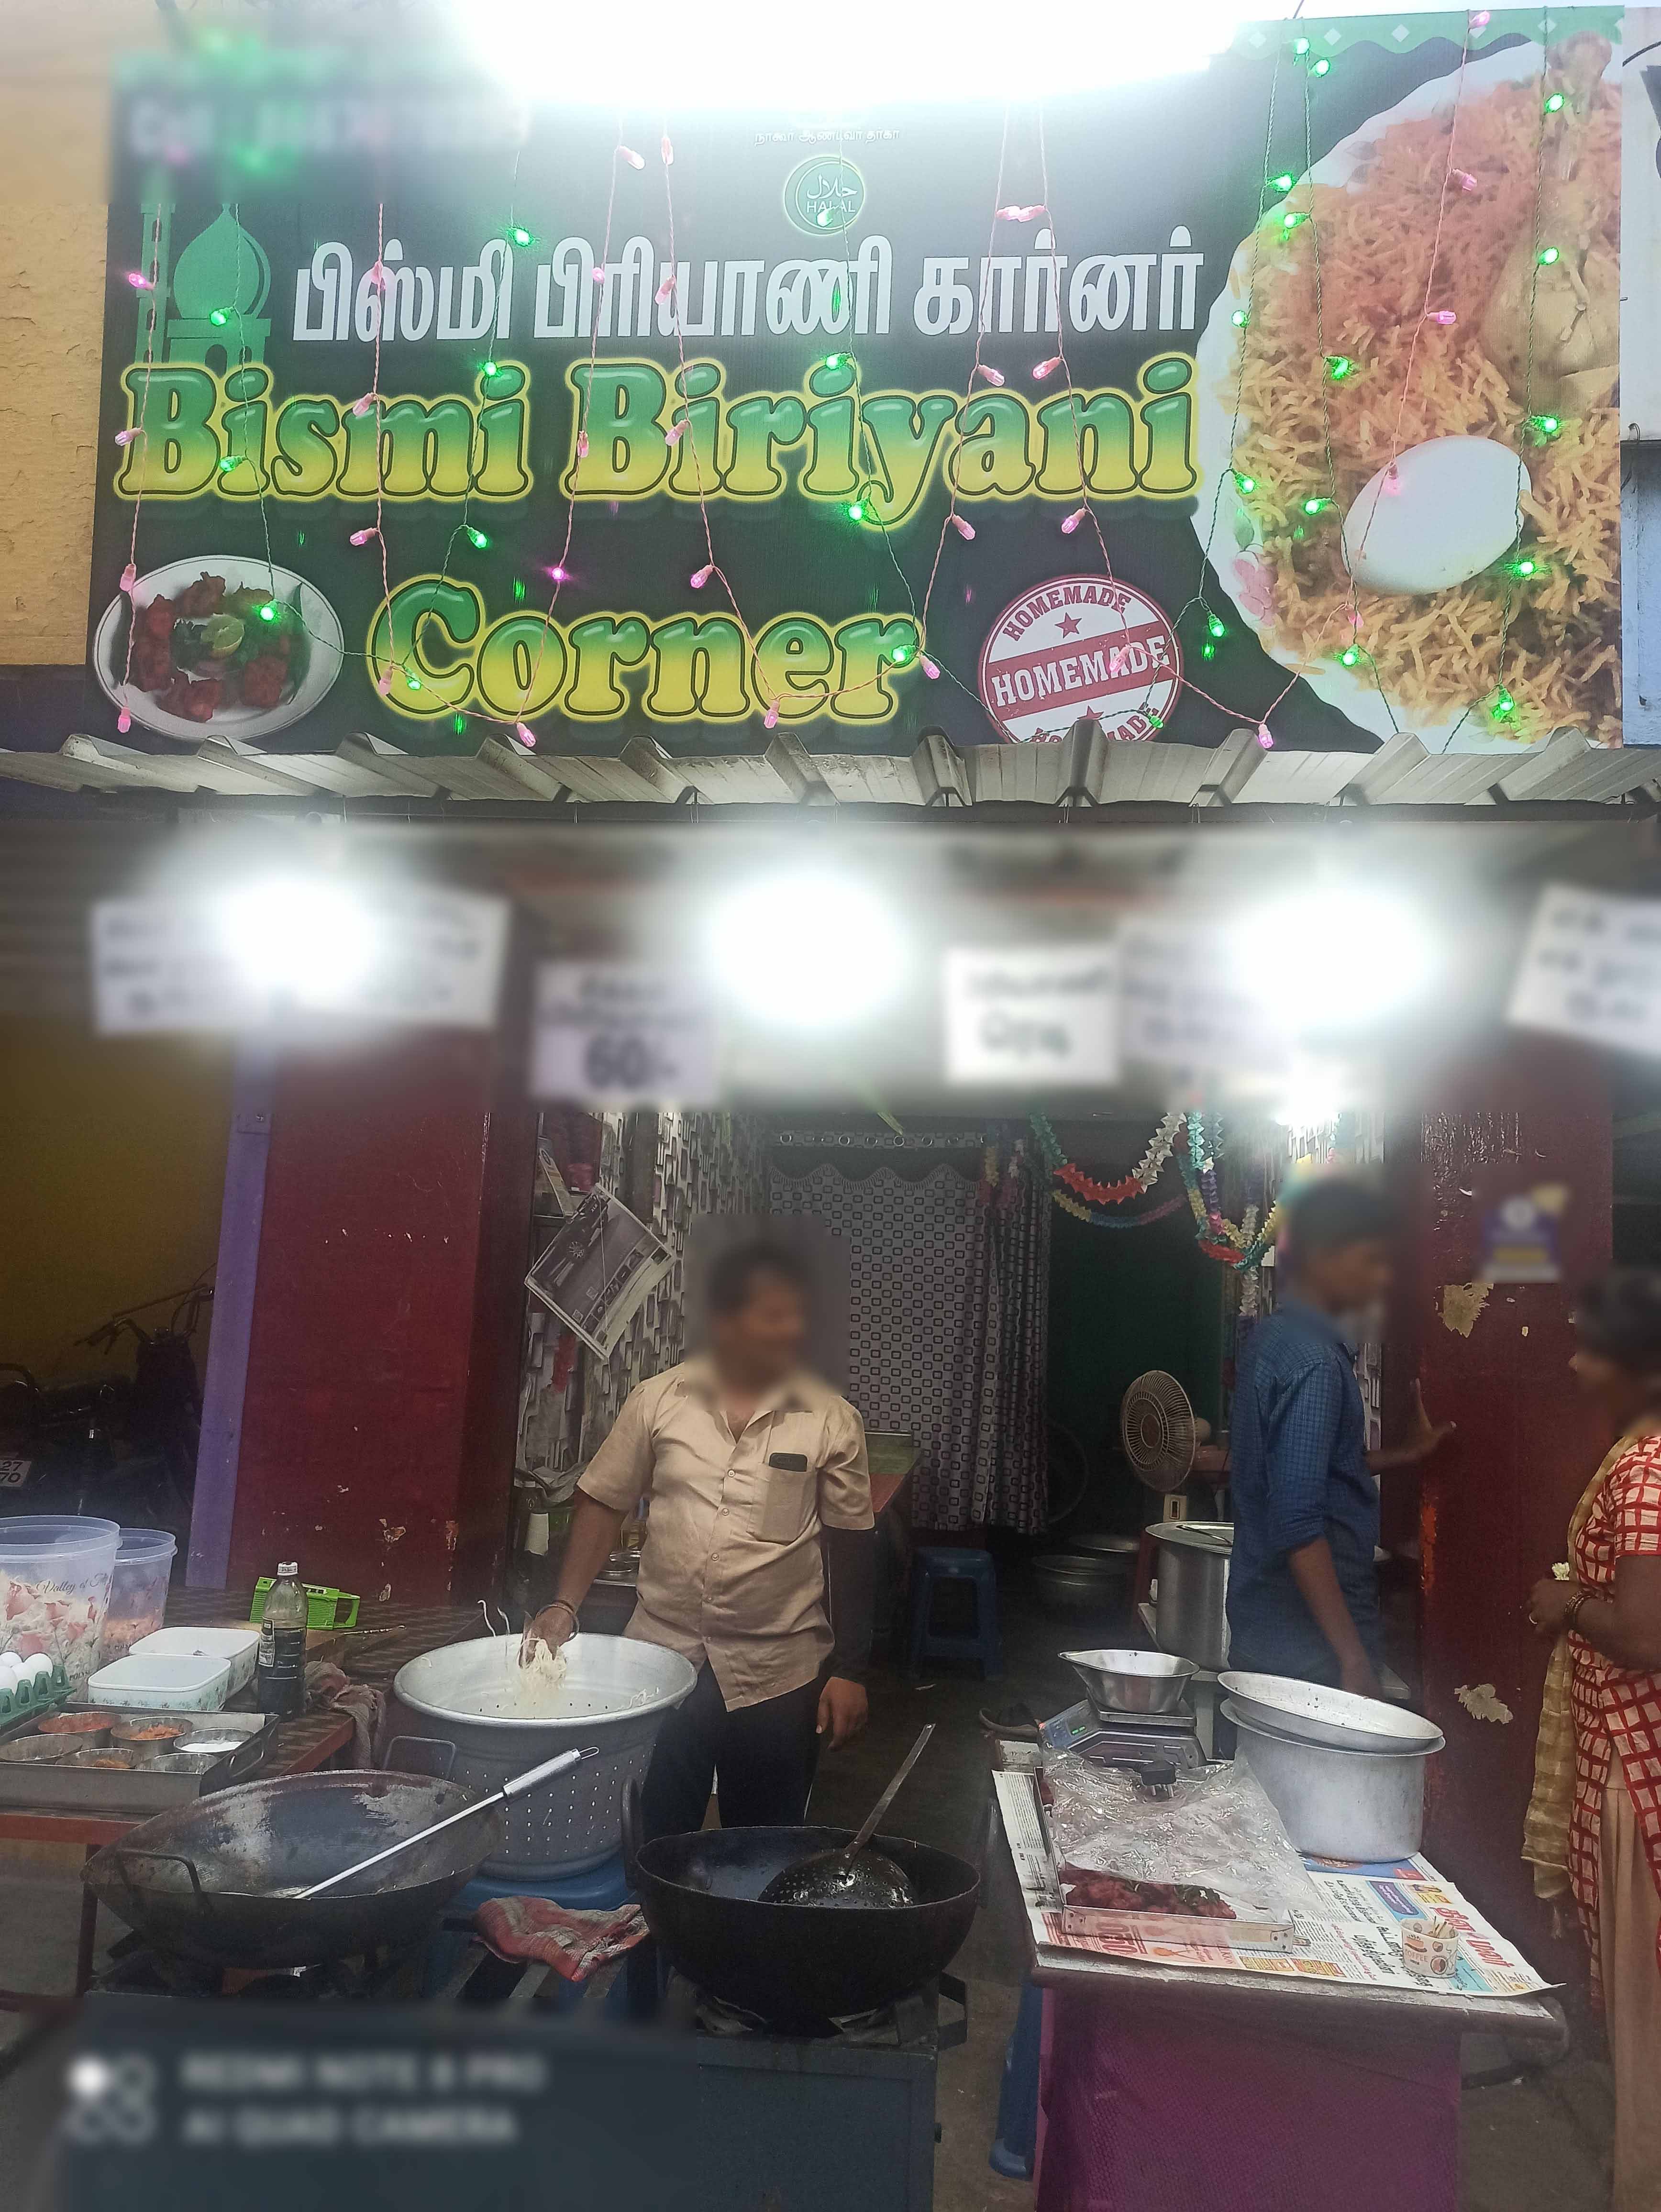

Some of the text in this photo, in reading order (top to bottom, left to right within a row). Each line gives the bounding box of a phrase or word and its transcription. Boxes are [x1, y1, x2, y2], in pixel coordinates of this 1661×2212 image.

[806, 174, 858, 200] حلال
[806, 200, 856, 213] HALAL
[293, 225, 1205, 342] பிஸ்மி பிரியாணி கார்னர்
[115, 355, 1198, 528] Bismi Biriyani
[1002, 586, 1132, 641] HOMEMADE
[368, 575, 922, 720] Corner
[991, 634, 1171, 708] HOMEMADE
[36, 1578, 76, 1595] Valley
